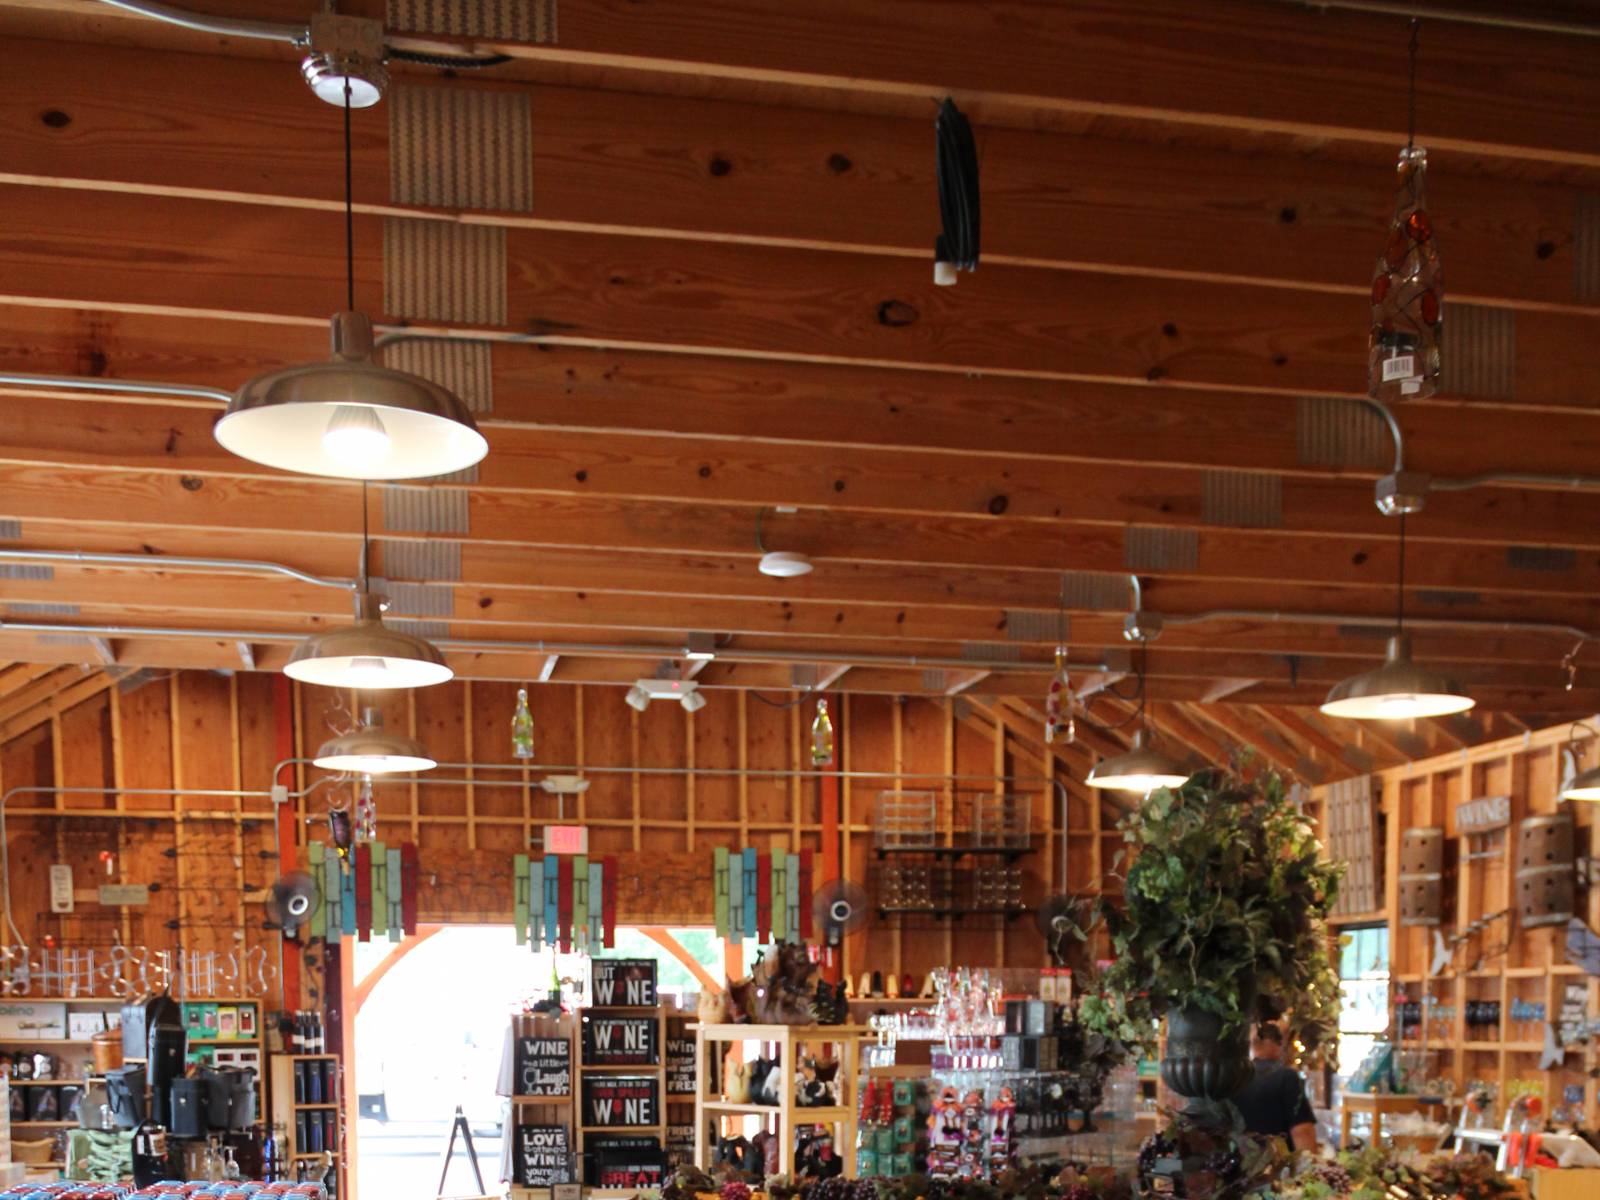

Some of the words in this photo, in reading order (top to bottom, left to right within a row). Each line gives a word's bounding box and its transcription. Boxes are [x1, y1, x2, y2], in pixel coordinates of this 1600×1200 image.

[525, 1041, 568, 1055] WINE
[667, 1041, 696, 1053] Win
[547, 1086, 569, 1095] LOT
[524, 1133, 566, 1146] LOVE
[524, 1154, 568, 1166] WINE
[601, 1171, 659, 1184] GREAT
